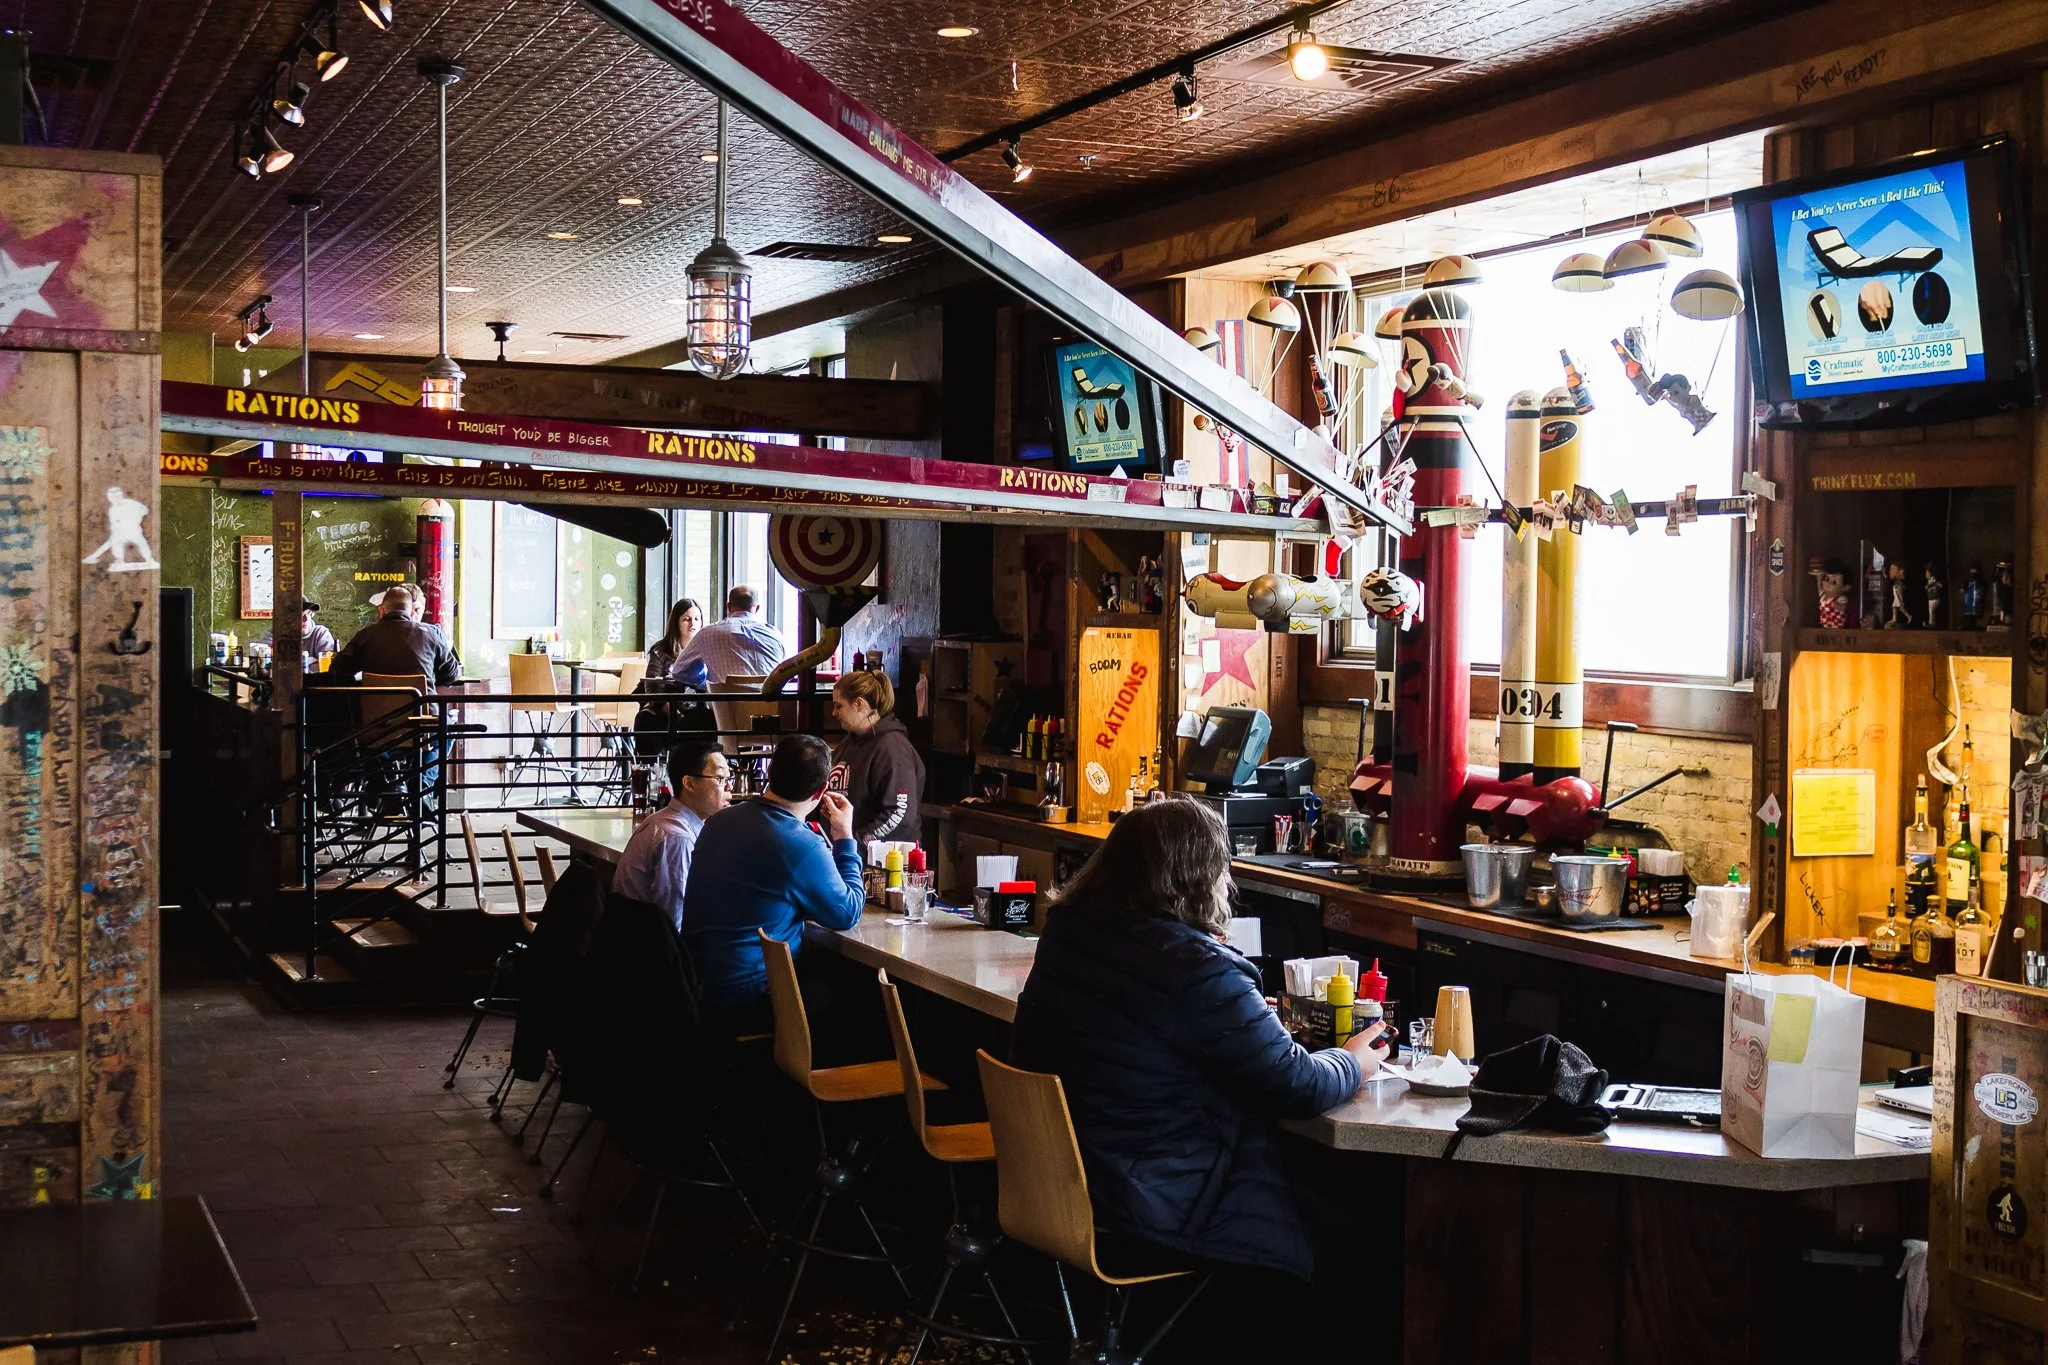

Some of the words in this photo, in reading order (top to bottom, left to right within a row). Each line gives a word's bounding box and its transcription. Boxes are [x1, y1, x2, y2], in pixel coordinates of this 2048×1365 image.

[1796, 65, 1818, 102] ARE
[1821, 59, 1843, 88] YOU
[1843, 48, 1888, 88] READY?
[868, 130, 898, 164] CALLING
[902, 155, 914, 174] ME
[1797, 209, 1809, 220] Bet
[1811, 204, 1834, 217] You've
[1837, 201, 1857, 213] Never
[1859, 196, 1877, 208] Seen
[1887, 191, 1902, 202] Bed
[1904, 189, 1921, 199] Like
[1924, 180, 1945, 195] This!
[1824, 357, 1863, 371] Craftmatic
[1881, 359, 1951, 374] MyCraftmaticBed.com
[1877, 342, 1953, 364] 800-230-5698
[226, 389, 360, 424] RATIONS
[447, 419, 451, 430] I
[457, 421, 506, 436] THOUGHT
[548, 431, 561, 442] BE
[568, 432, 611, 448] BIGGER
[648, 432, 756, 463] RATIONS
[161, 455, 209, 472] IONS
[290, 465, 304, 476] IS
[439, 473, 454, 485] IS
[635, 483, 679, 494] MANY
[1000, 468, 1087, 494] RATIONS
[354, 572, 405, 582] RATIONS
[1089, 658, 1121, 674] BOOM
[1096, 661, 1149, 750] RATIONS
[1800, 871, 1825, 926] LICKER
[1986, 1077, 2028, 1095] LAKEFRONT
